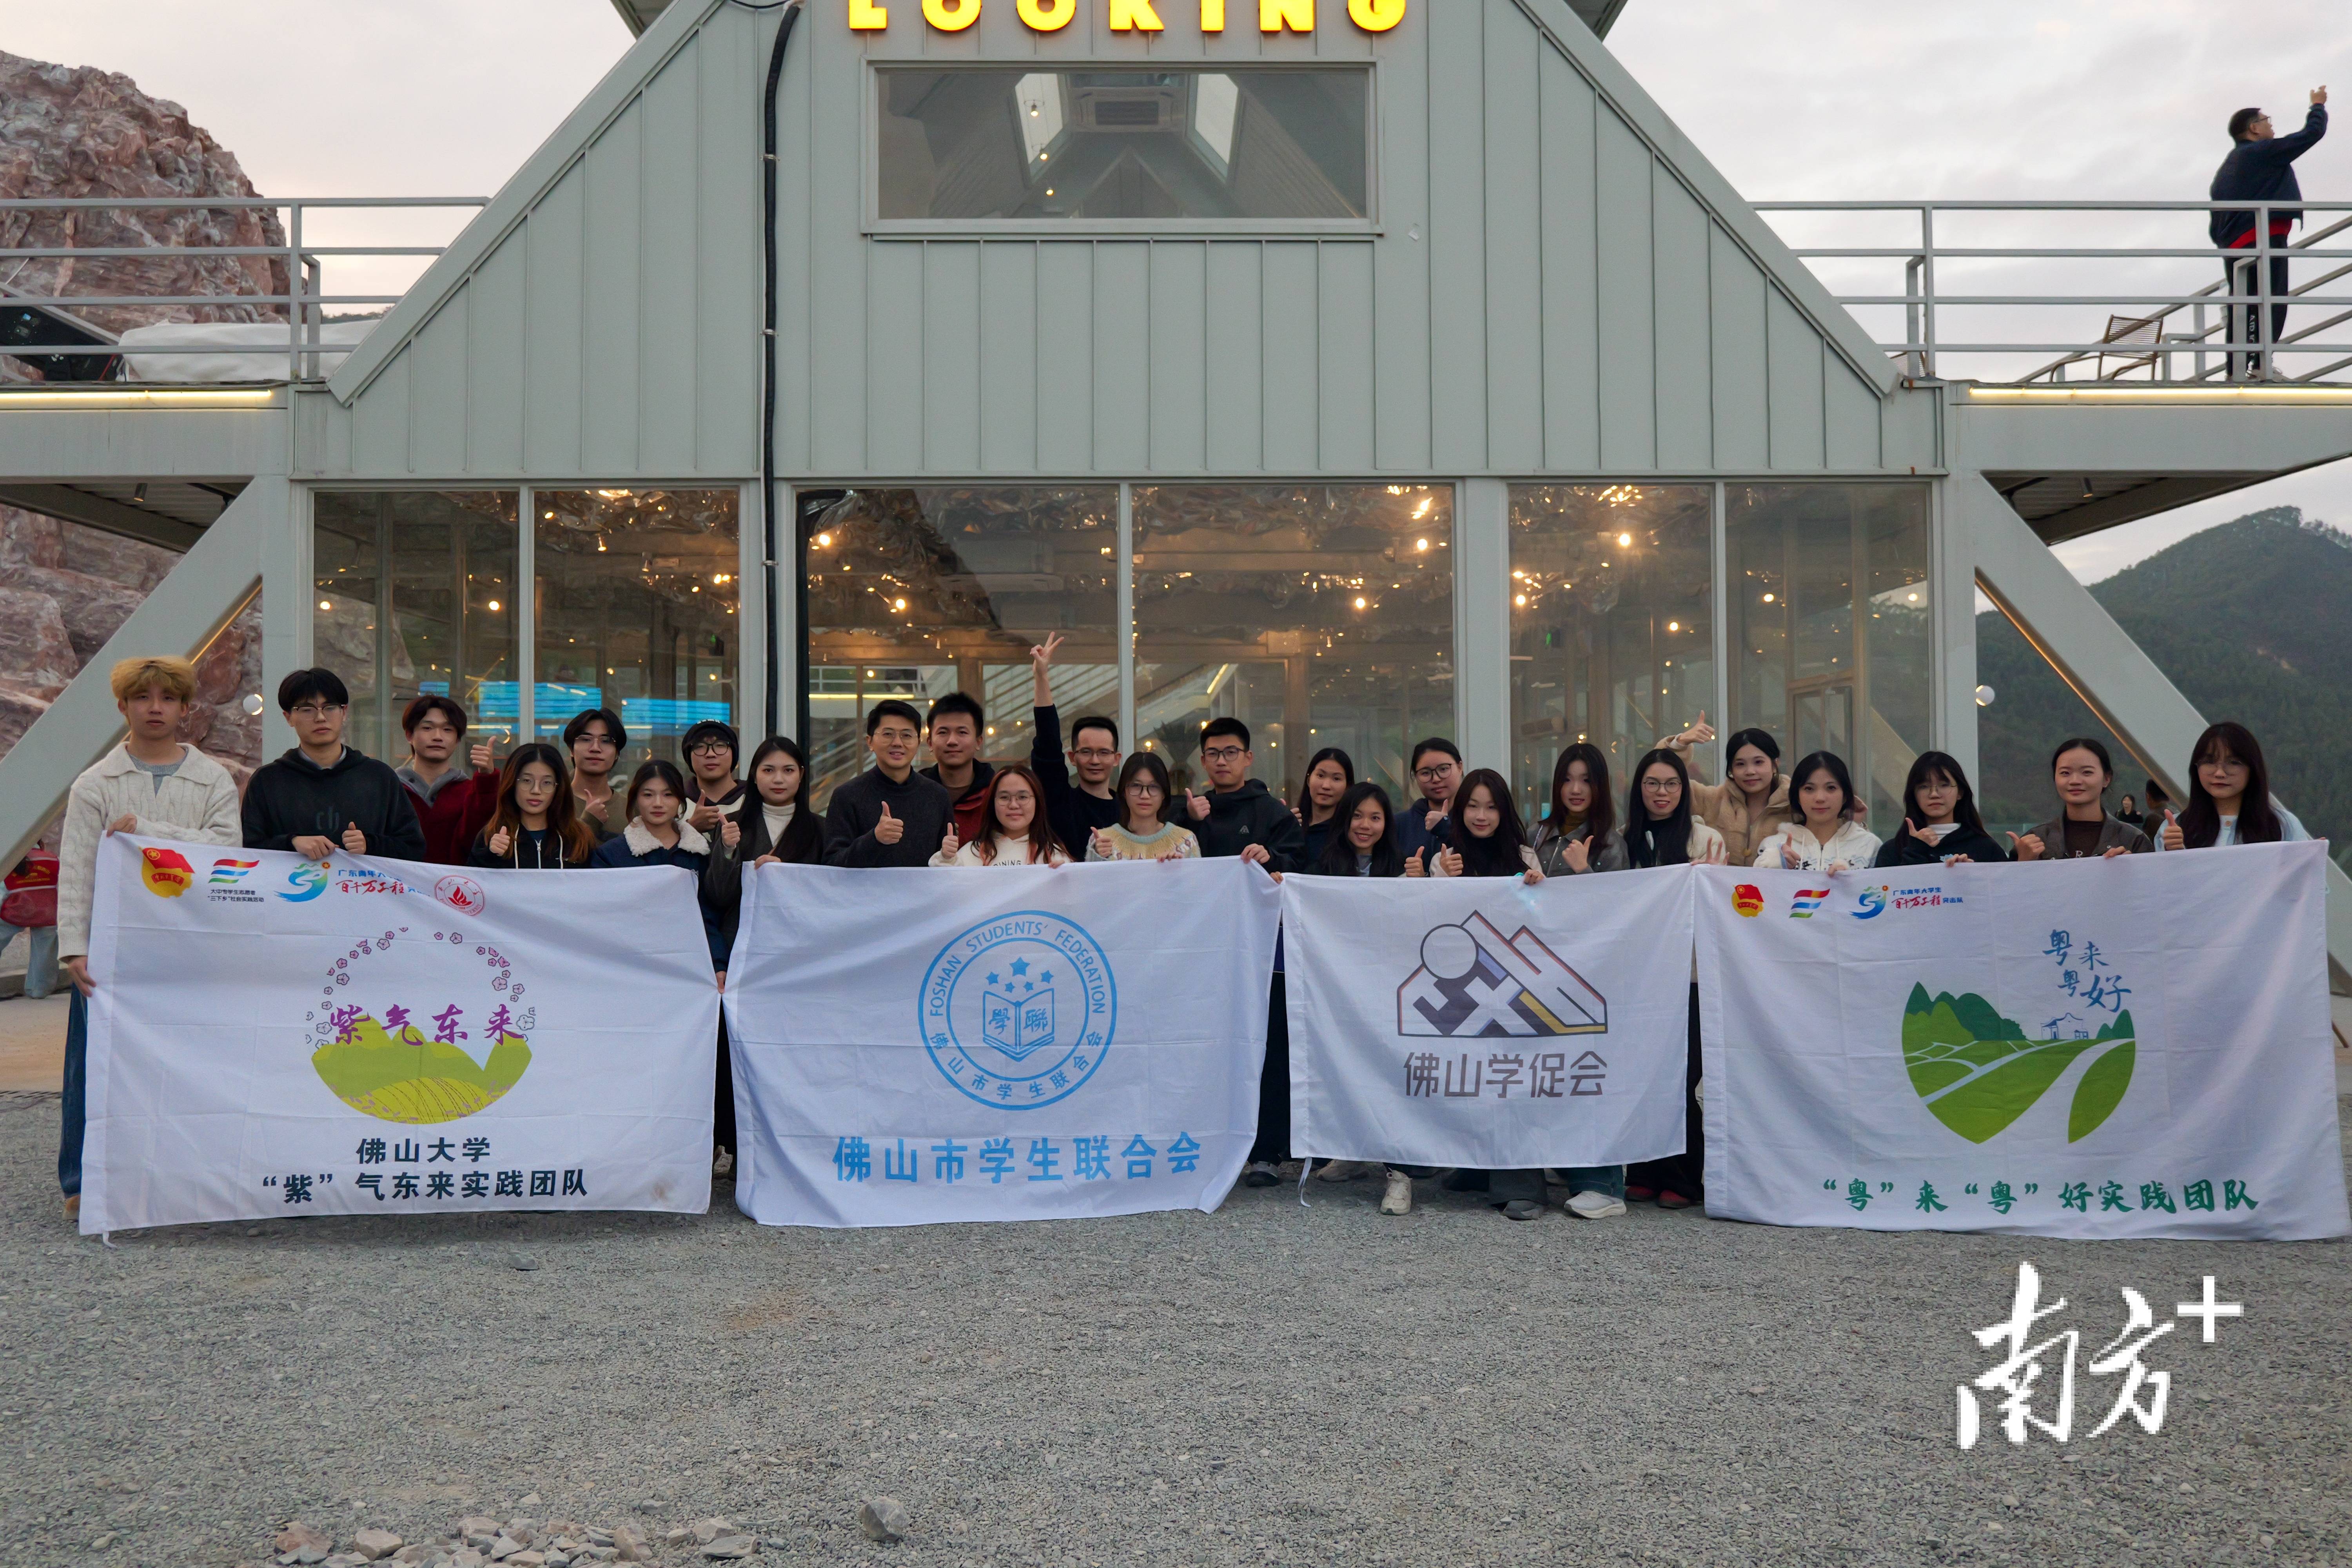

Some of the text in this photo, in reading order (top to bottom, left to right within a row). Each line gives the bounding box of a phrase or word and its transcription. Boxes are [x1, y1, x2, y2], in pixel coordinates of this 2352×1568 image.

[336, 880, 405, 895] 百千万工程
[339, 869, 401, 881] 广东青年大
[1893, 887, 1942, 896] 广东青年大学生
[930, 955, 962, 1016] FOSHAN
[1055, 929, 1105, 1013] FEDERATION
[330, 1004, 524, 1046] 紫气东来
[930, 1031, 1103, 1100] 佛山市学生联合会
[1403, 1051, 1607, 1098] 佛山学促会
[356, 1137, 491, 1164] 佛山大学
[832, 1131, 1201, 1184] 佛山市学生联合会
